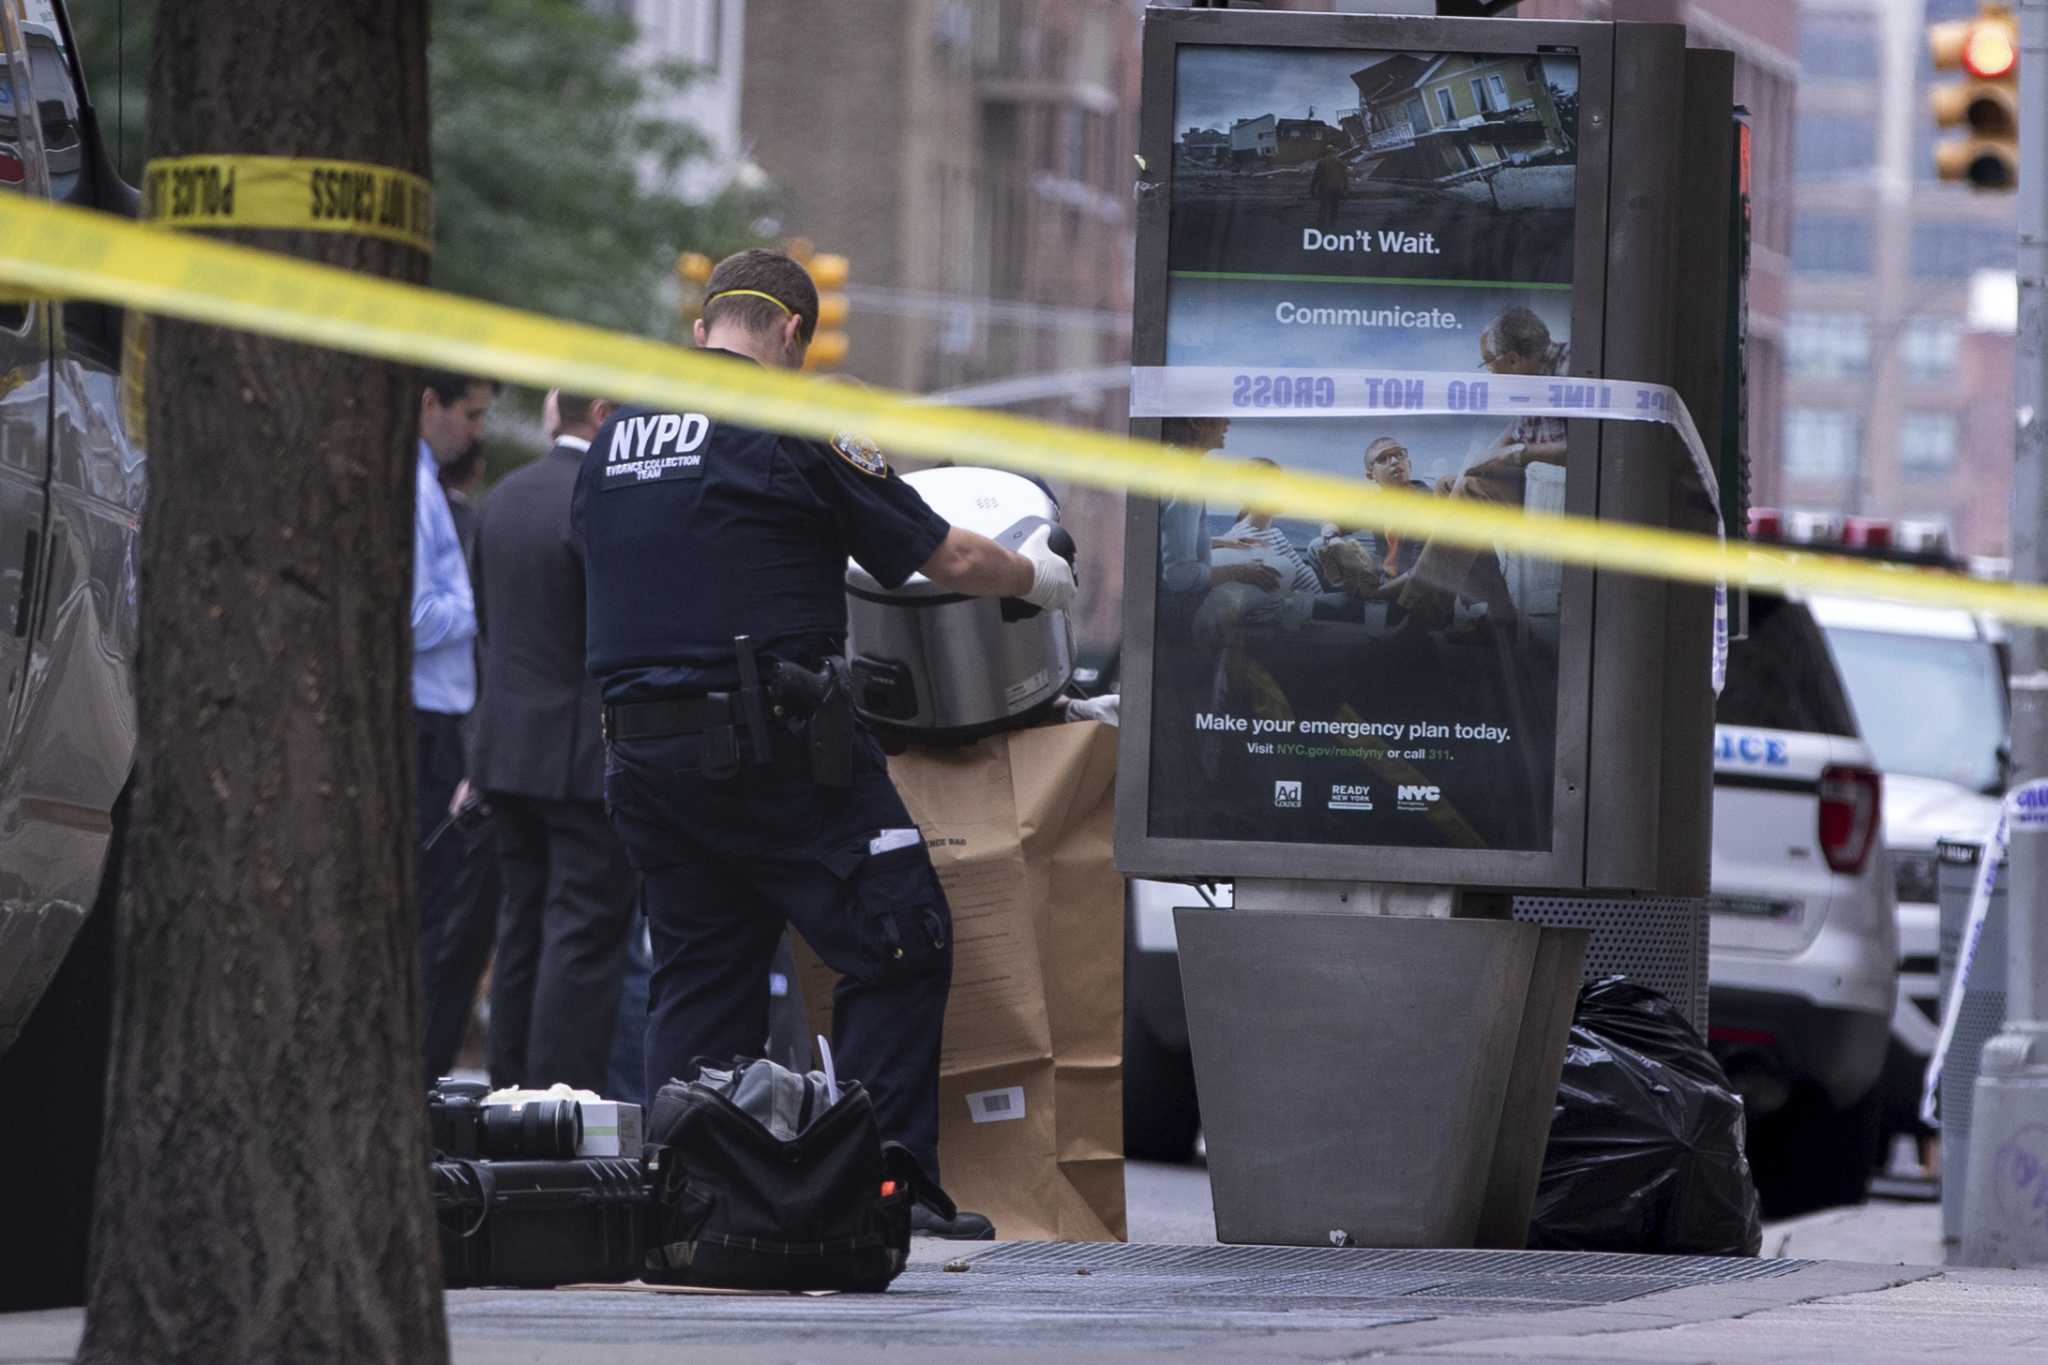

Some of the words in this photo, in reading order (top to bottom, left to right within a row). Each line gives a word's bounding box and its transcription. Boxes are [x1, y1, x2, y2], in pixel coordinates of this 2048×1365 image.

[171, 164, 235, 217] POLICE
[1303, 228, 1373, 252] Don't
[1378, 231, 1441, 254] Wait.
[1275, 302, 1463, 330] Communicate.
[608, 413, 709, 462] NYPD
[606, 461, 643, 477] EVIDENCE
[644, 456, 701, 471] COLLECTION
[637, 468, 663, 481] TEAM
[1195, 713, 1248, 731] Make
[1252, 718, 1296, 735] your
[1299, 720, 1405, 740] emergency
[1409, 721, 1450, 740] plan
[1454, 723, 1512, 744] today.
[1246, 742, 1275, 754] Visit
[1387, 750, 1400, 759] or
[1404, 749, 1426, 760] call
[1715, 735, 1790, 766] ICE
[1276, 785, 1299, 800] Ad
[1332, 785, 1371, 796] READY
[1397, 785, 1441, 801] NYC
